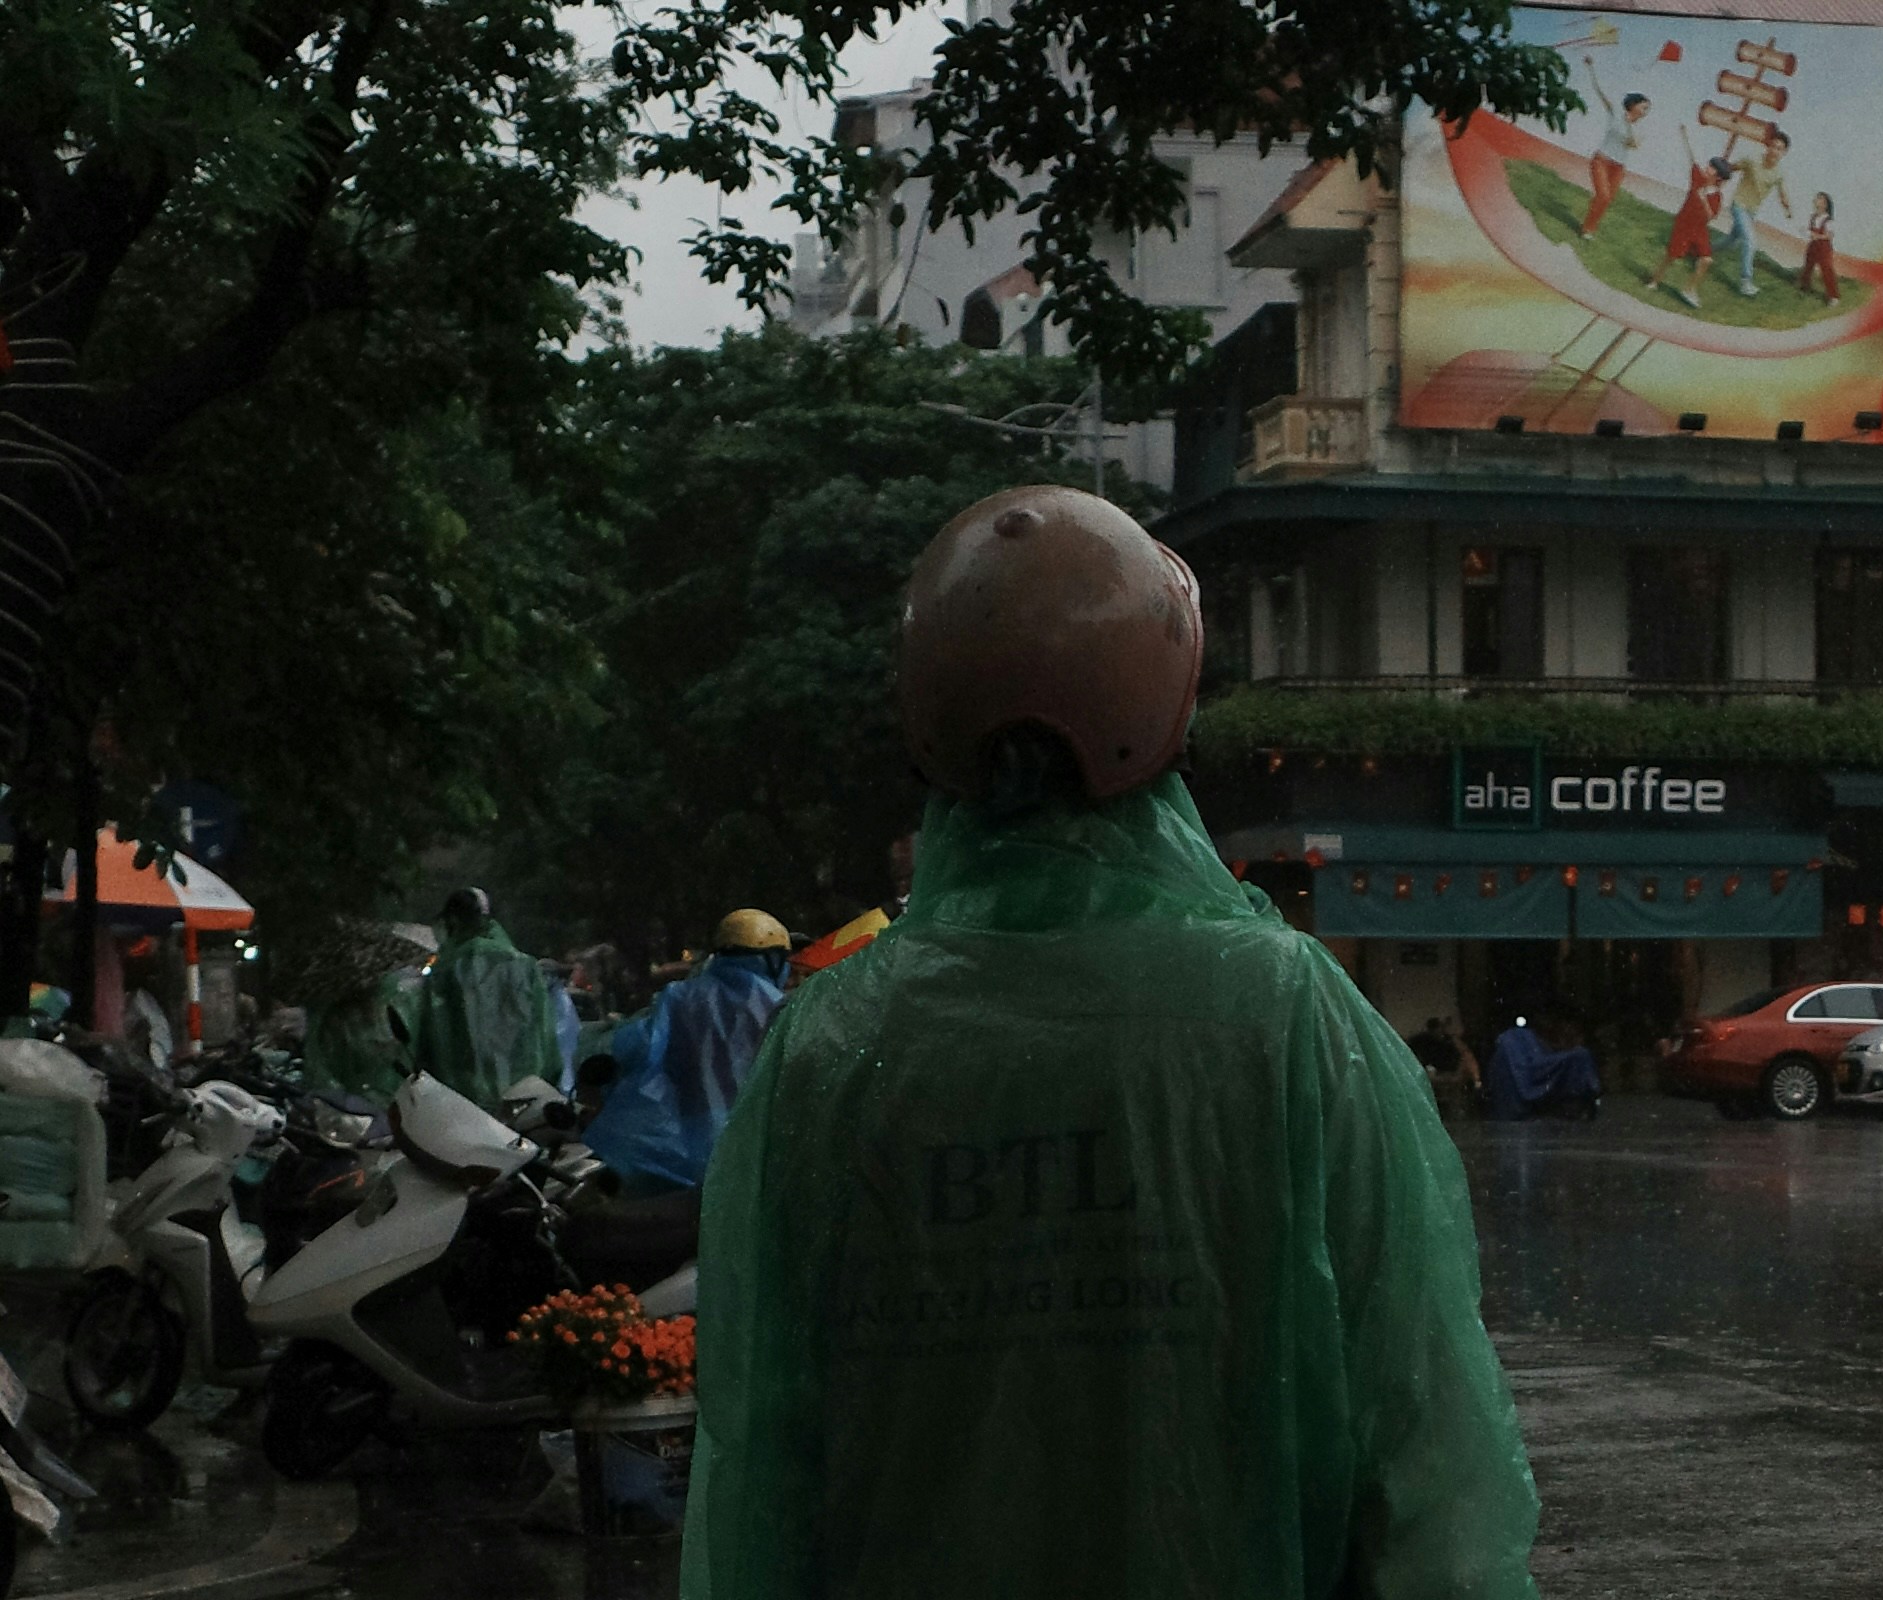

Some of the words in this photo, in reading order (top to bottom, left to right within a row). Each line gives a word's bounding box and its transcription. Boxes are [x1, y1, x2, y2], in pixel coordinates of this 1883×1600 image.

[1464, 771, 1530, 809] aha
[1550, 766, 1725, 812] coffee
[923, 1128, 1137, 1226] BTL
